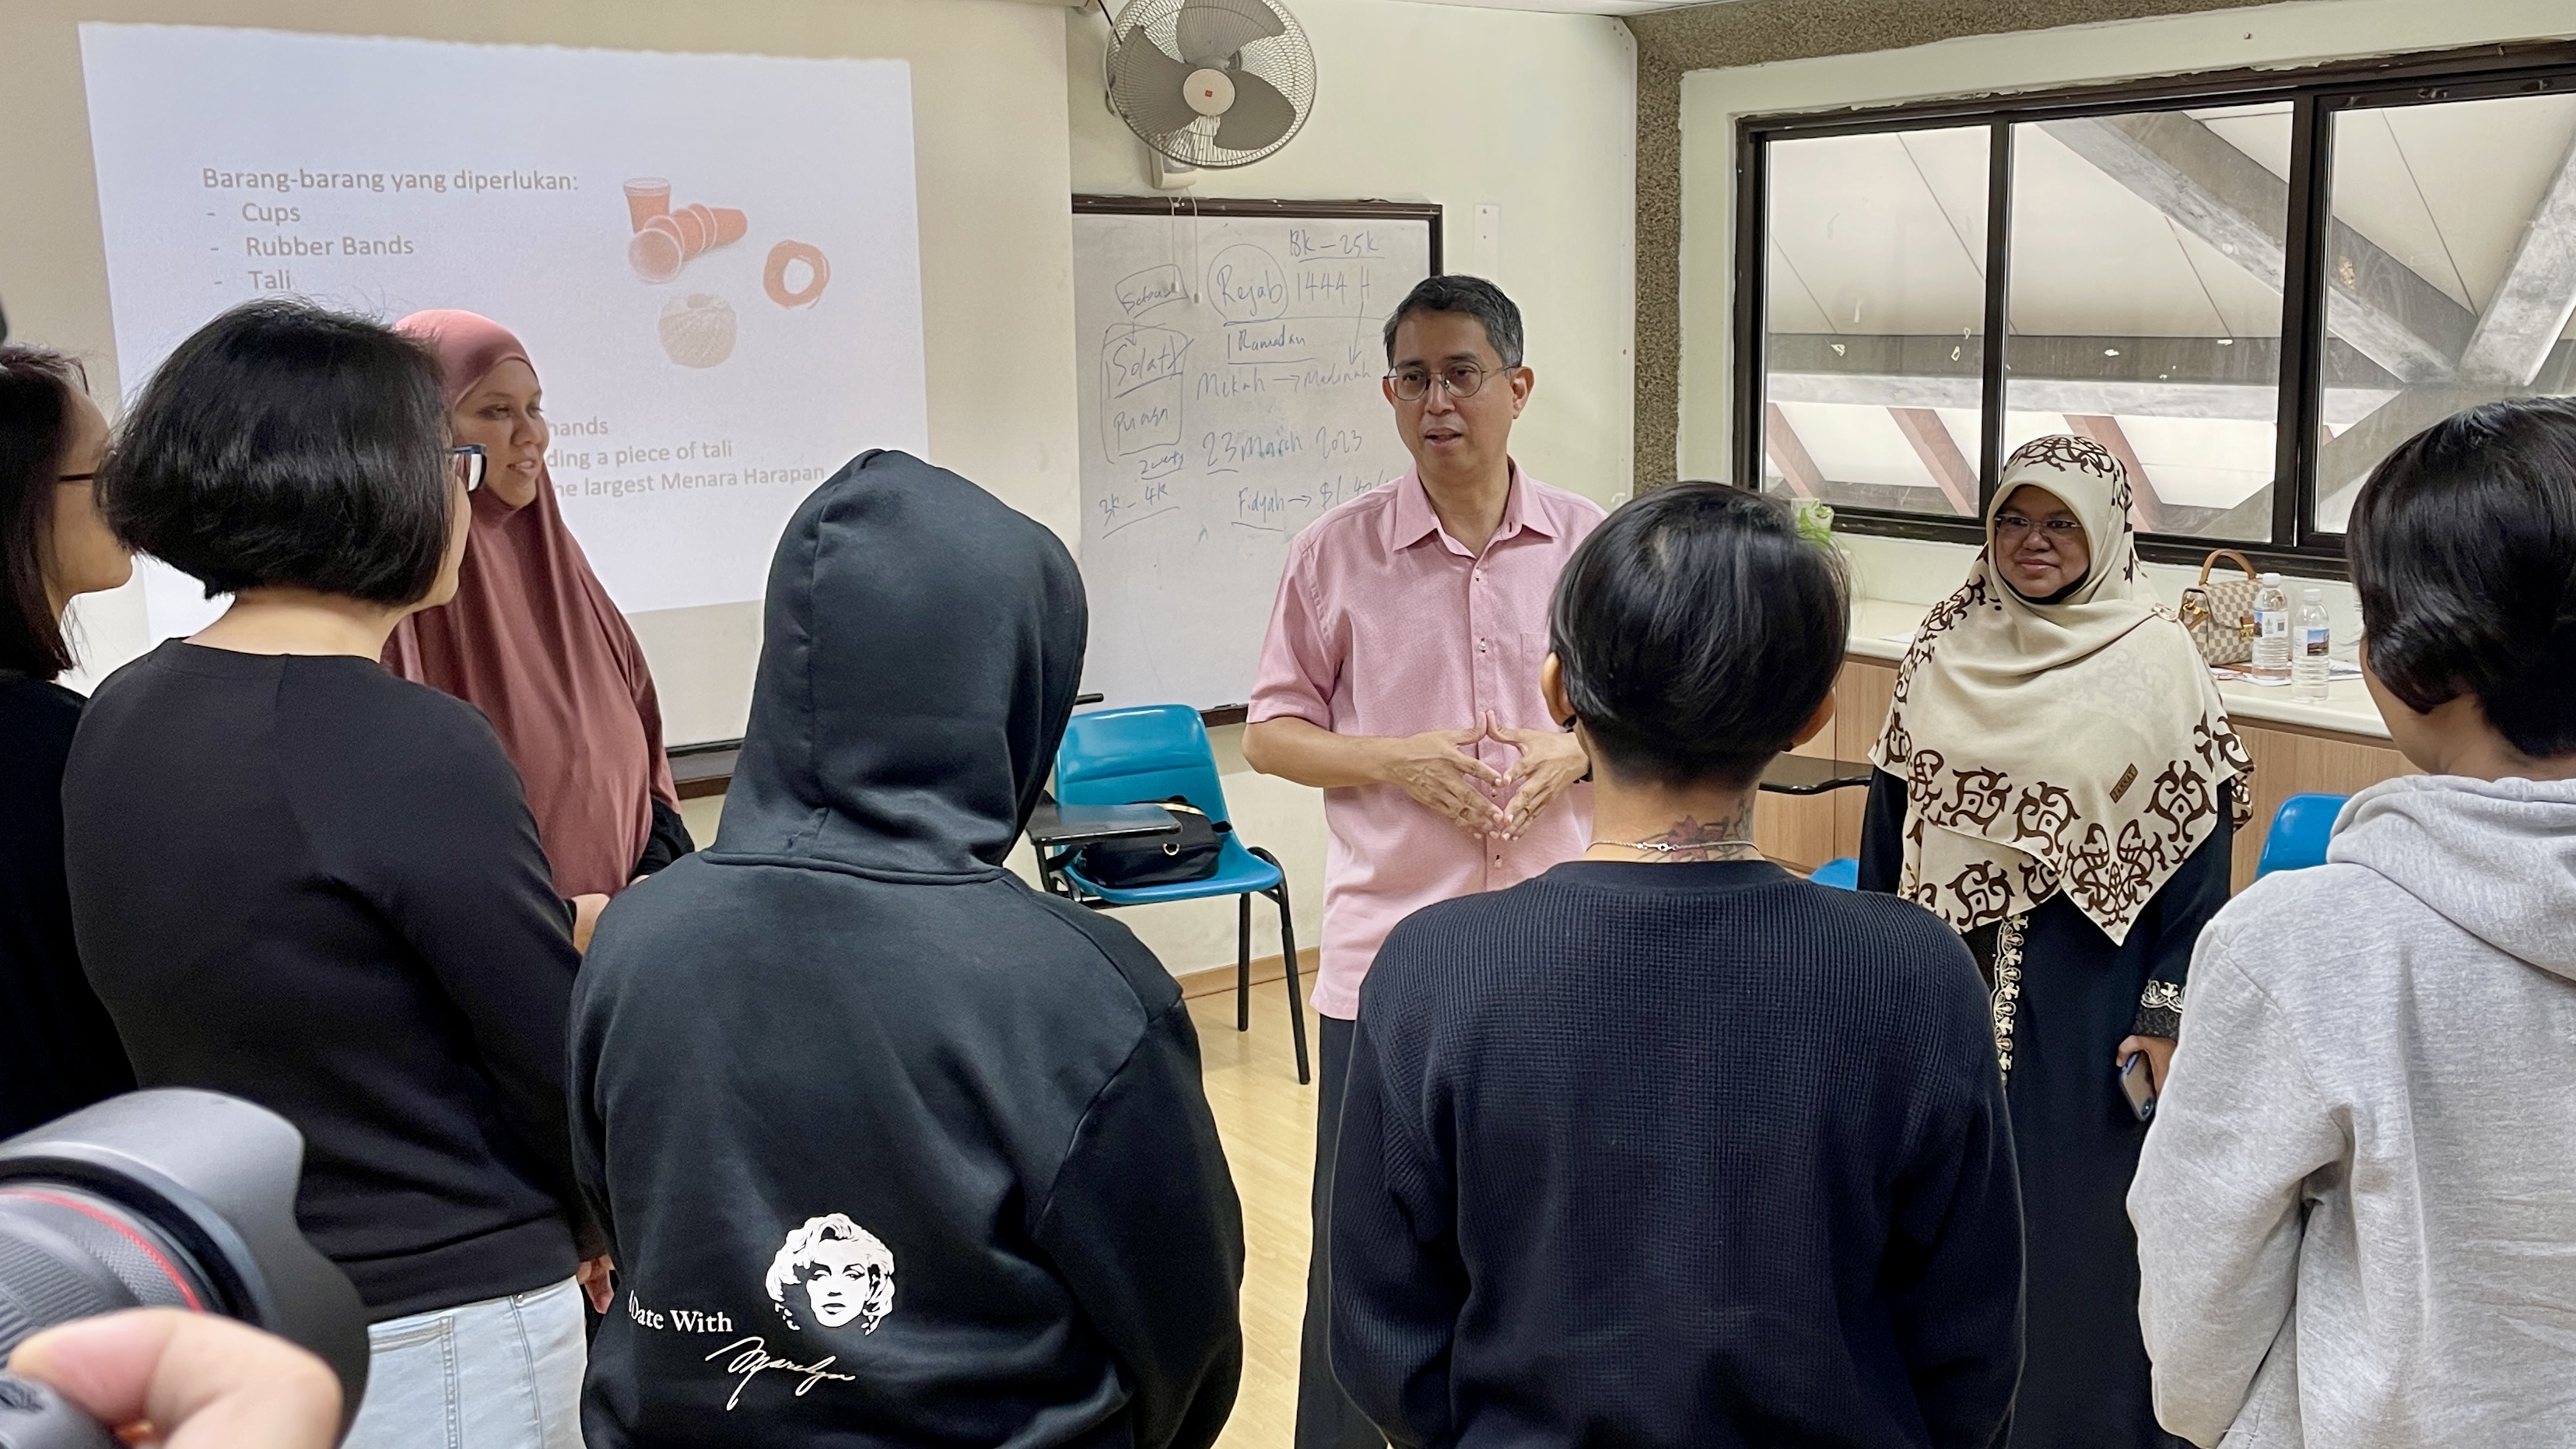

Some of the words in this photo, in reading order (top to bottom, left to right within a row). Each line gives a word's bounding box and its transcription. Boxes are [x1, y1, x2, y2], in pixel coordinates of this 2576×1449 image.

[202, 167, 384, 193] Barang-barang
[391, 173, 447, 193] yang
[454, 170, 579, 193] diperlukan:
[241, 202, 301, 226] Cups
[246, 236, 335, 257] Rubber
[342, 234, 414, 255] Bands
[247, 269, 291, 290] Tali
[597, 451, 608, 465] a
[615, 445, 670, 468] piece
[676, 440, 697, 461] of
[703, 439, 733, 459] tali
[1316, 426, 1362, 459] 2023
[584, 476, 655, 498] largest
[661, 471, 738, 490] Menara
[744, 467, 825, 486] Harapan
[669, 1310, 733, 1333] With
